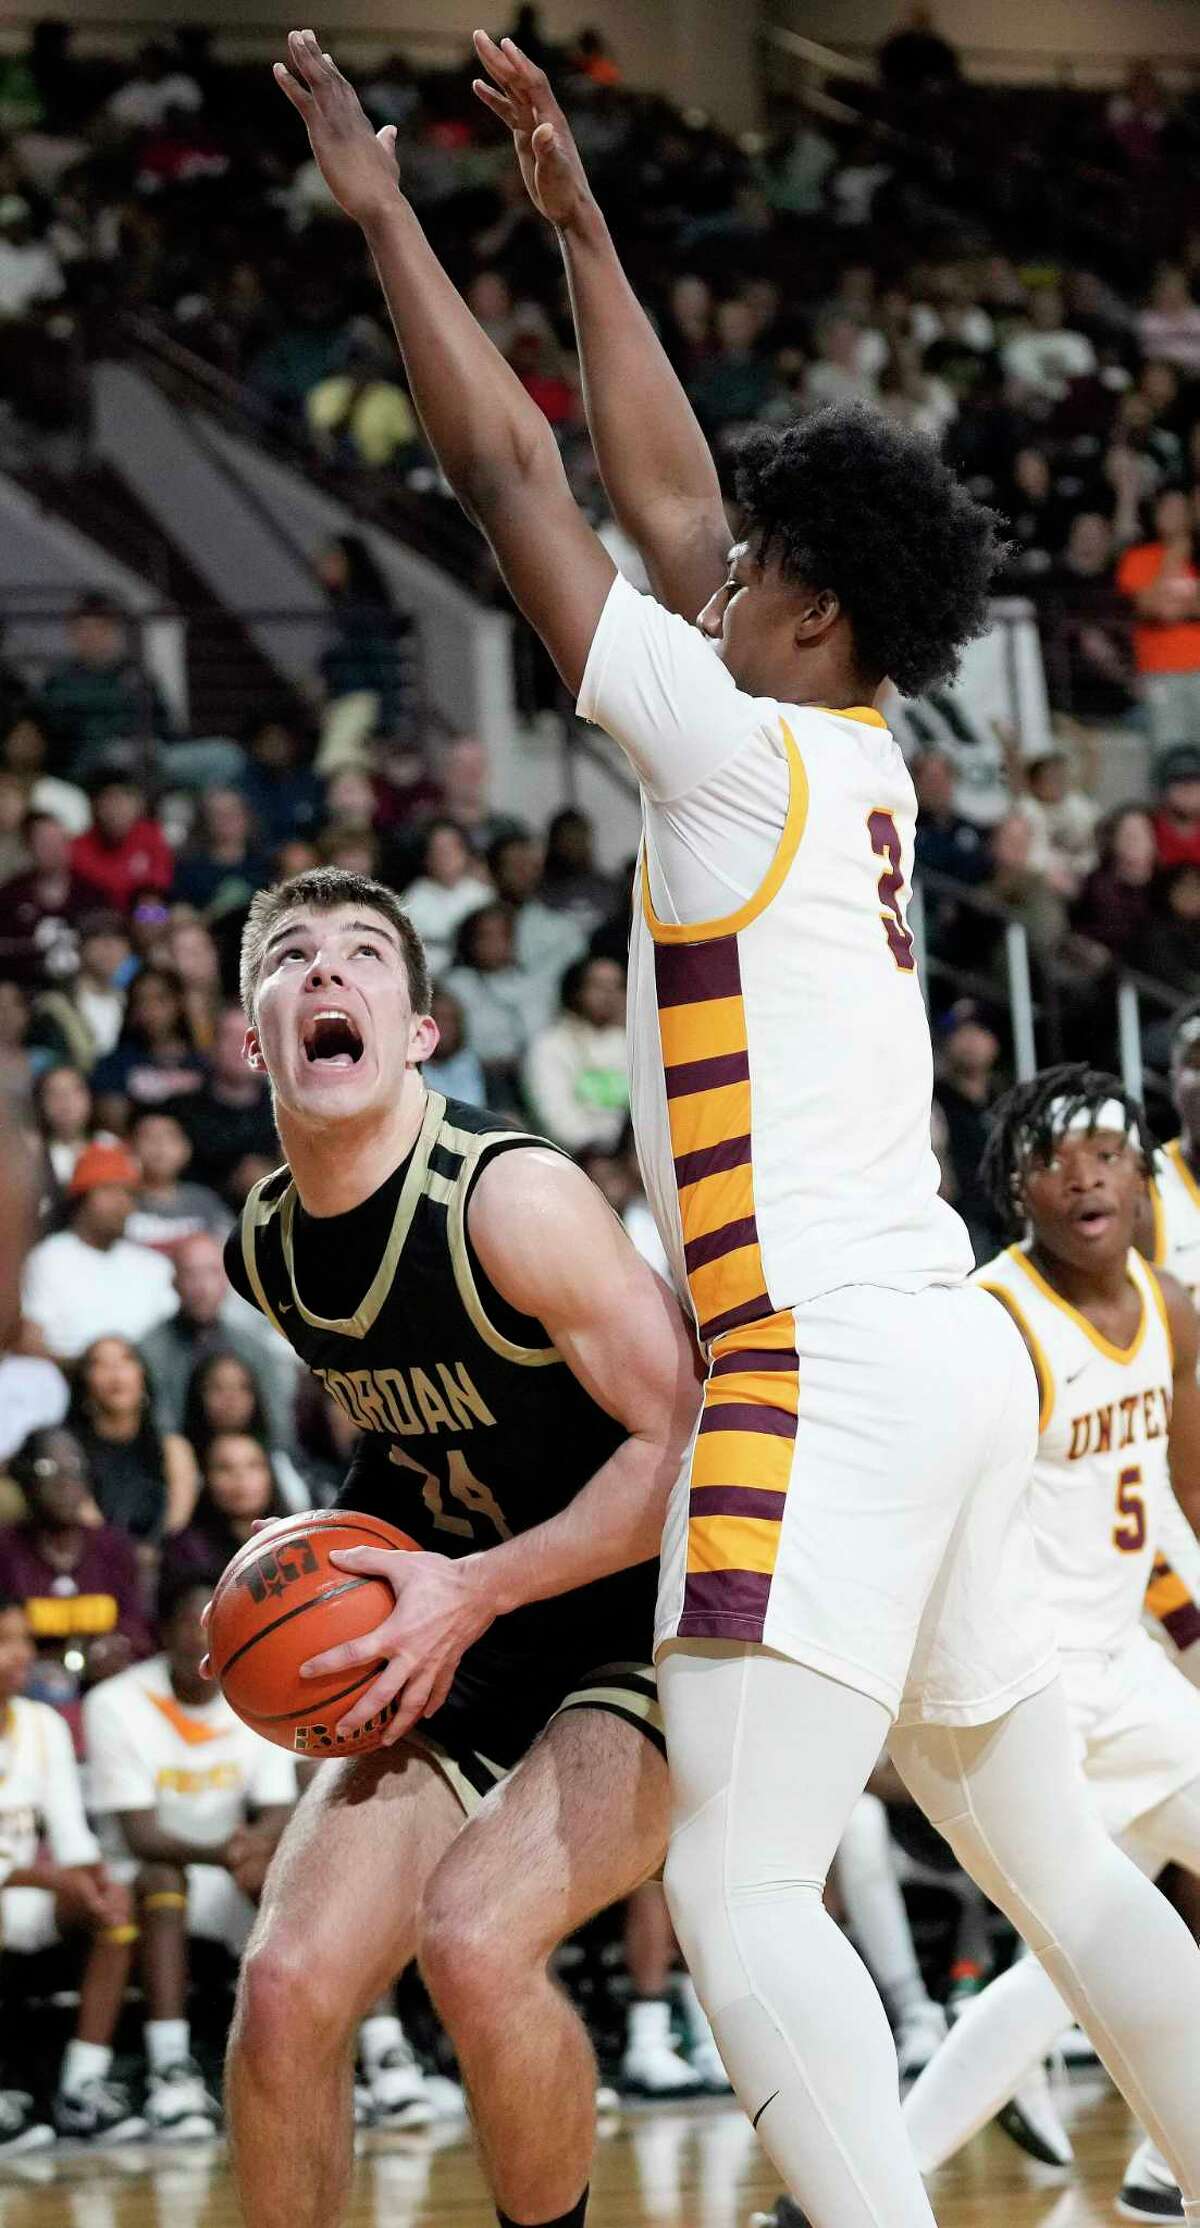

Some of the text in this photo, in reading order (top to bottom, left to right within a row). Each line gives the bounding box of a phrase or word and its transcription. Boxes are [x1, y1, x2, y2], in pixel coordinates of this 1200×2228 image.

[866, 807, 915, 975] 3
[388, 1443, 513, 1542] 24
[1113, 1464, 1146, 1553] 5
